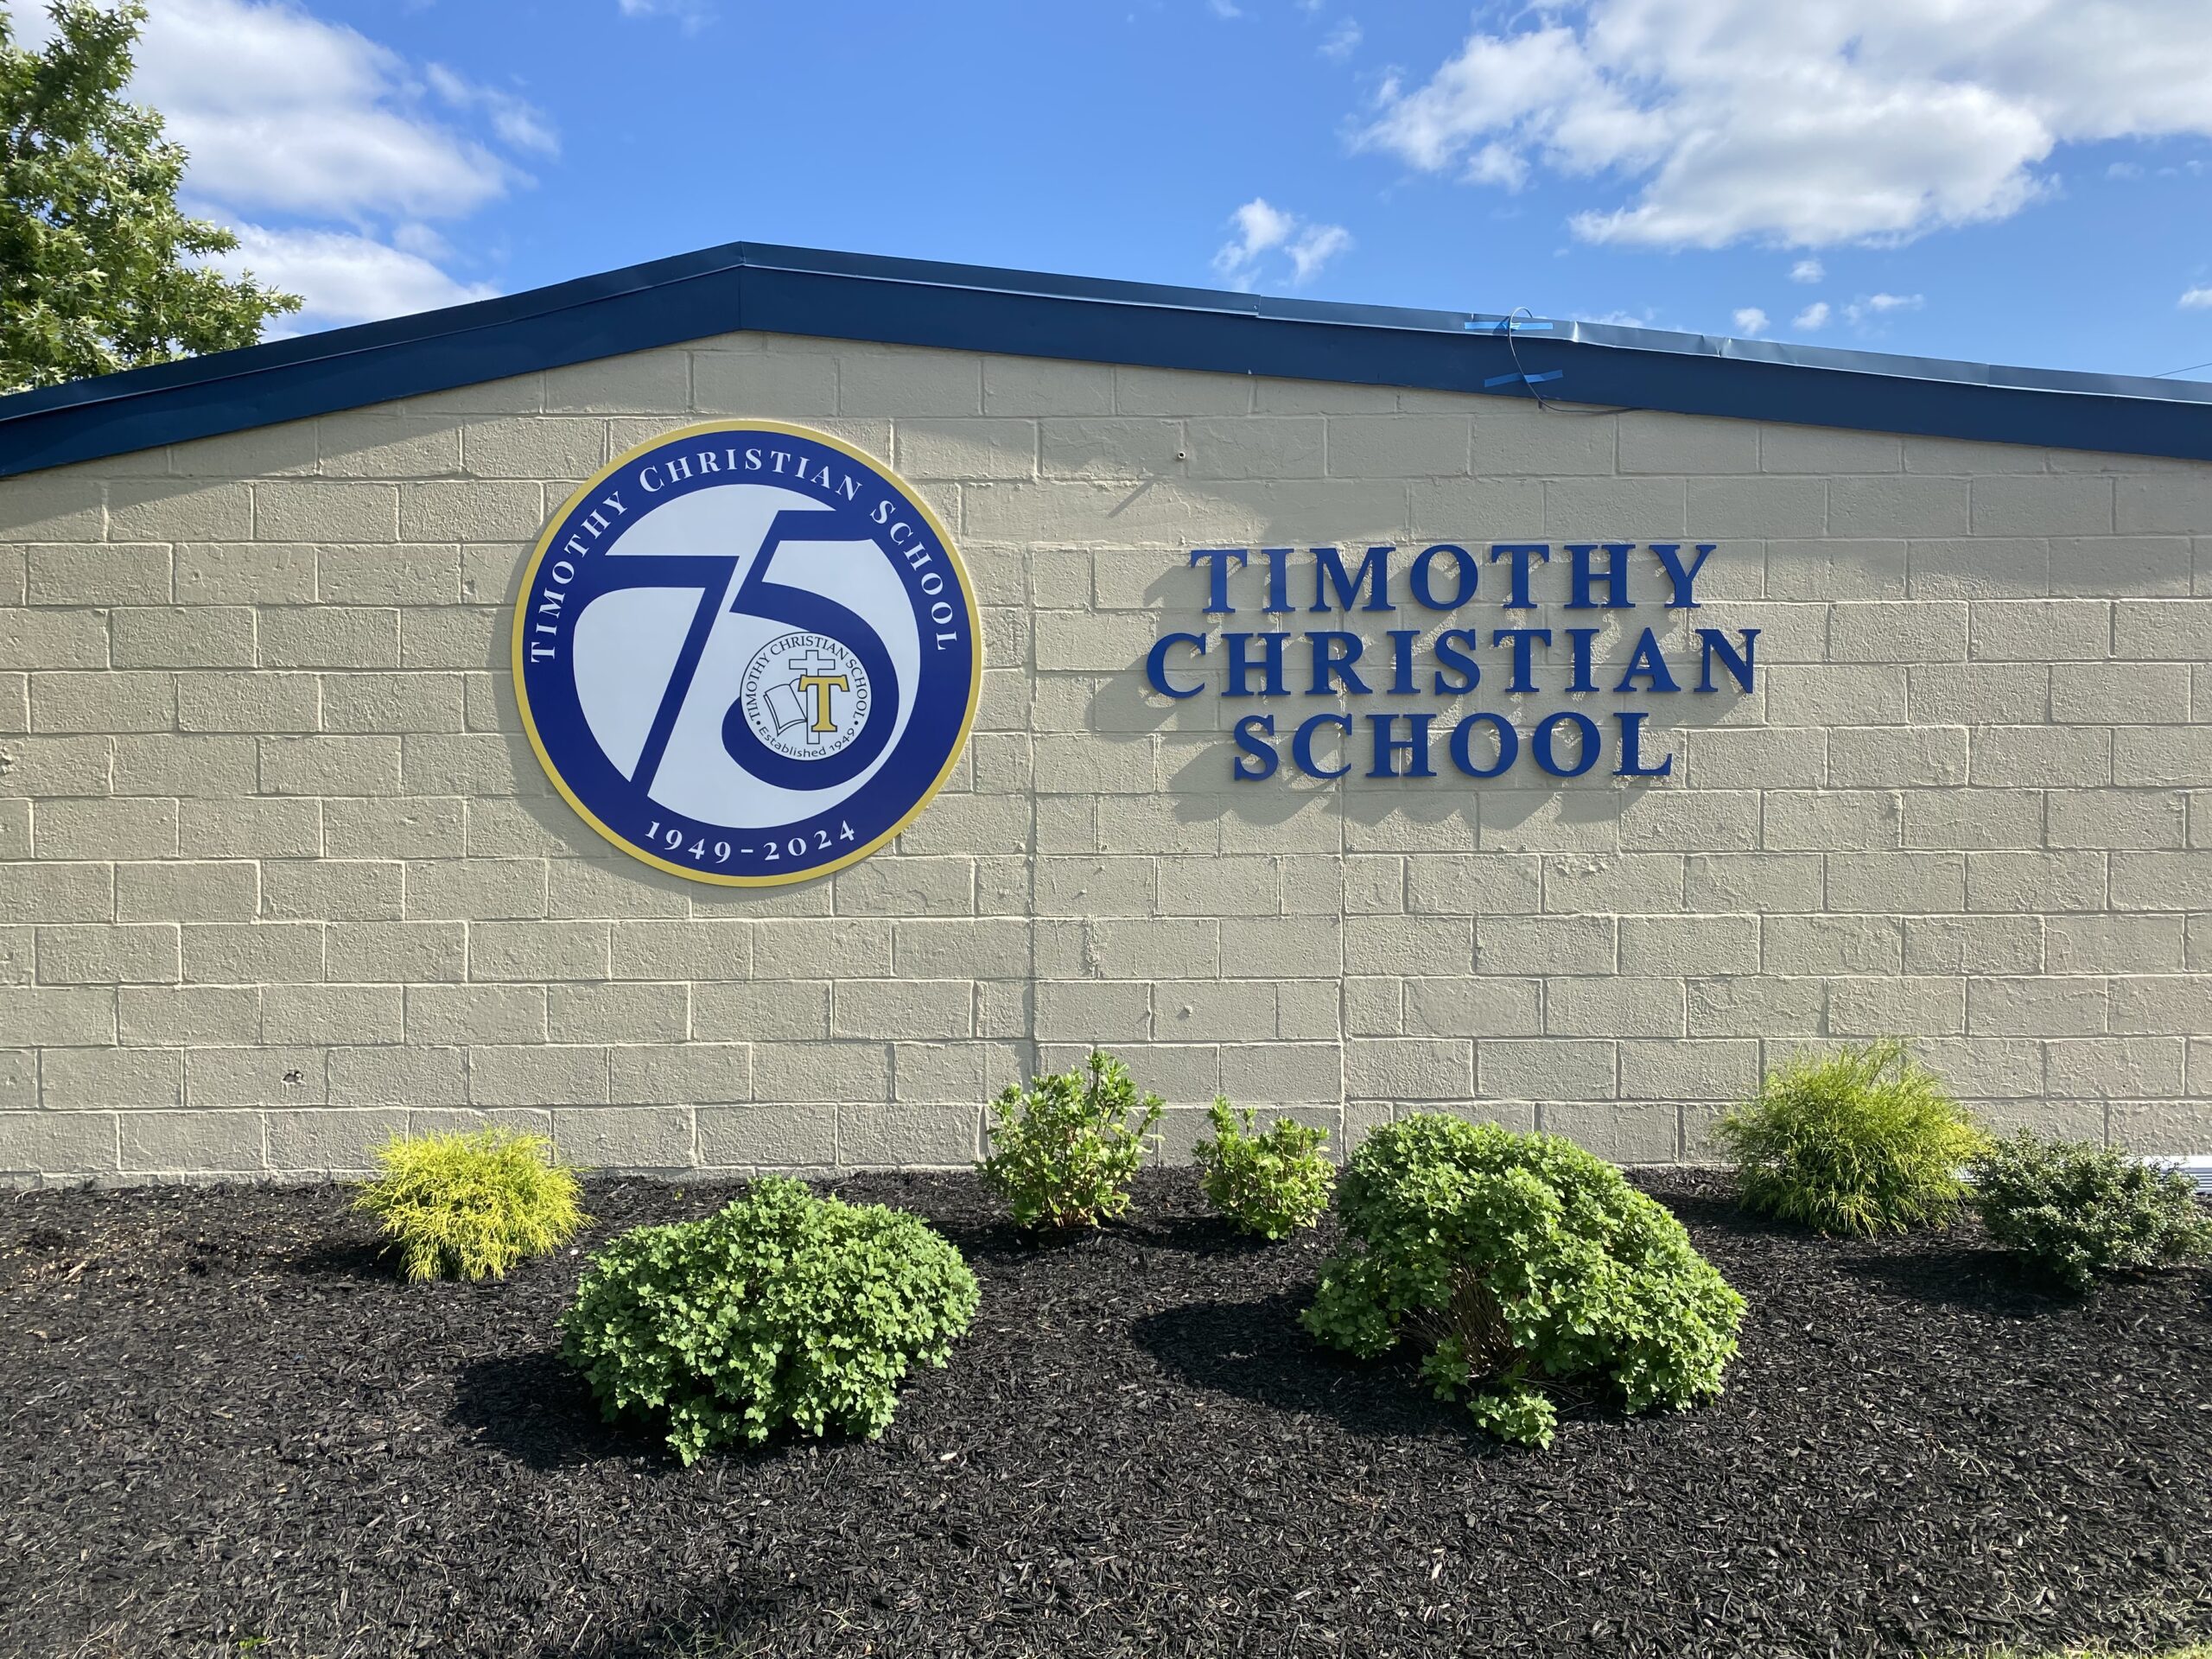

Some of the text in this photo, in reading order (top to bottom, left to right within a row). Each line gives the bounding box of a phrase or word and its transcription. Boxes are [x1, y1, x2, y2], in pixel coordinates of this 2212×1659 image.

[531, 448, 957, 664] TIMOTHY CHRISTIAN SCHOOL
[1190, 543, 1717, 614] TIMOTHY
[575, 510, 899, 797] 75
[746, 635, 868, 721] TIMOTHY CHRISTIAN SCHOOL
[1146, 626, 1762, 699] CHRISTIAN
[798, 674, 851, 733] T
[758, 726, 855, 759] Established 1949
[1234, 711, 1673, 782] SCHOOL
[644, 820, 855, 864] 1949-2024
